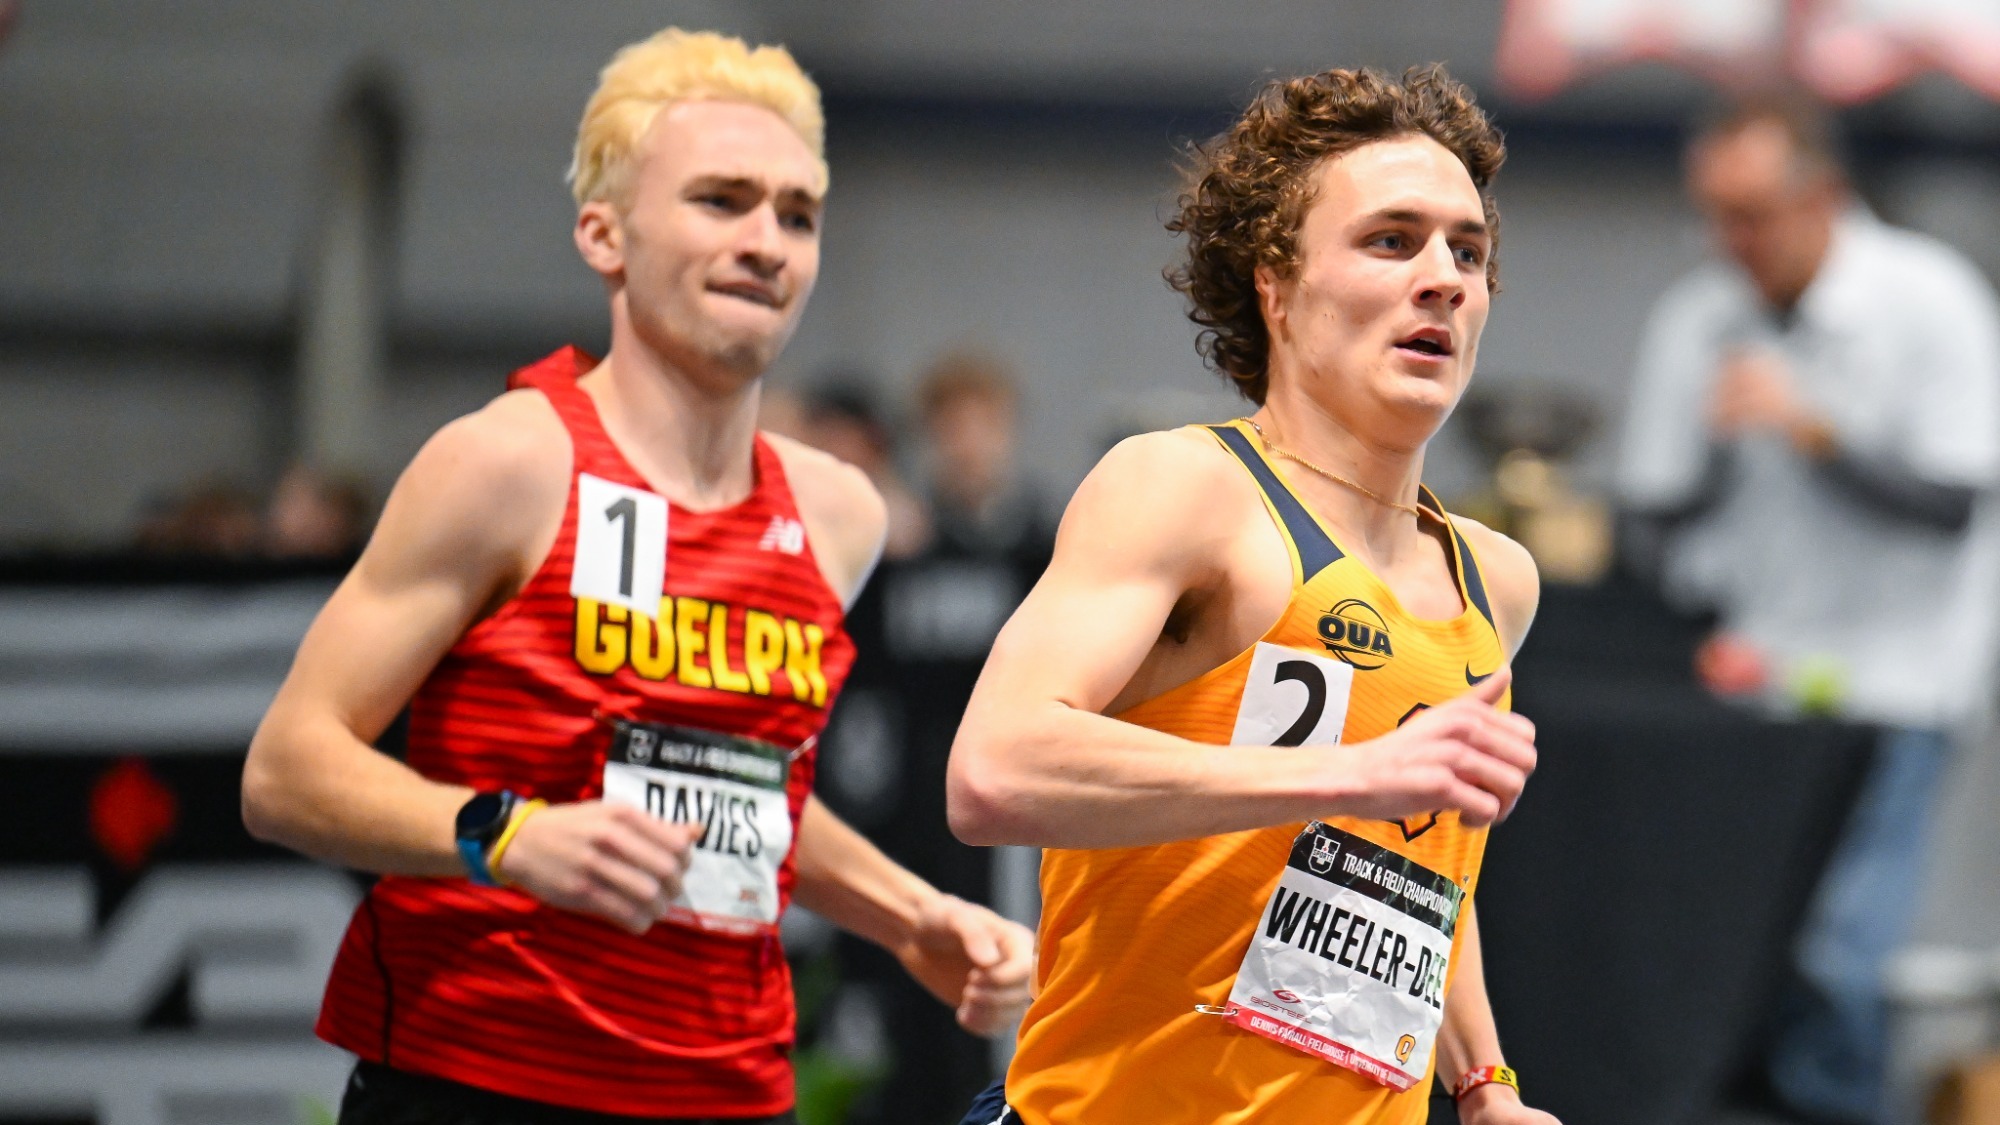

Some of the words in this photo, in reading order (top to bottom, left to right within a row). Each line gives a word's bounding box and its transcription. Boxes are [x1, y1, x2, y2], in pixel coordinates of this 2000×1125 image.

[605, 496, 637, 597] 1
[574, 595, 828, 708] GUELPH
[1316, 614, 1395, 658] OUA
[1269, 659, 1327, 747] 2
[1341, 852, 1375, 881] TRACK
[1373, 865, 1382, 885] &
[1381, 868, 1404, 894] FIELD
[1265, 886, 1447, 1010] WHEELER-DEE
[1249, 1016, 1279, 1036] DENNIS
